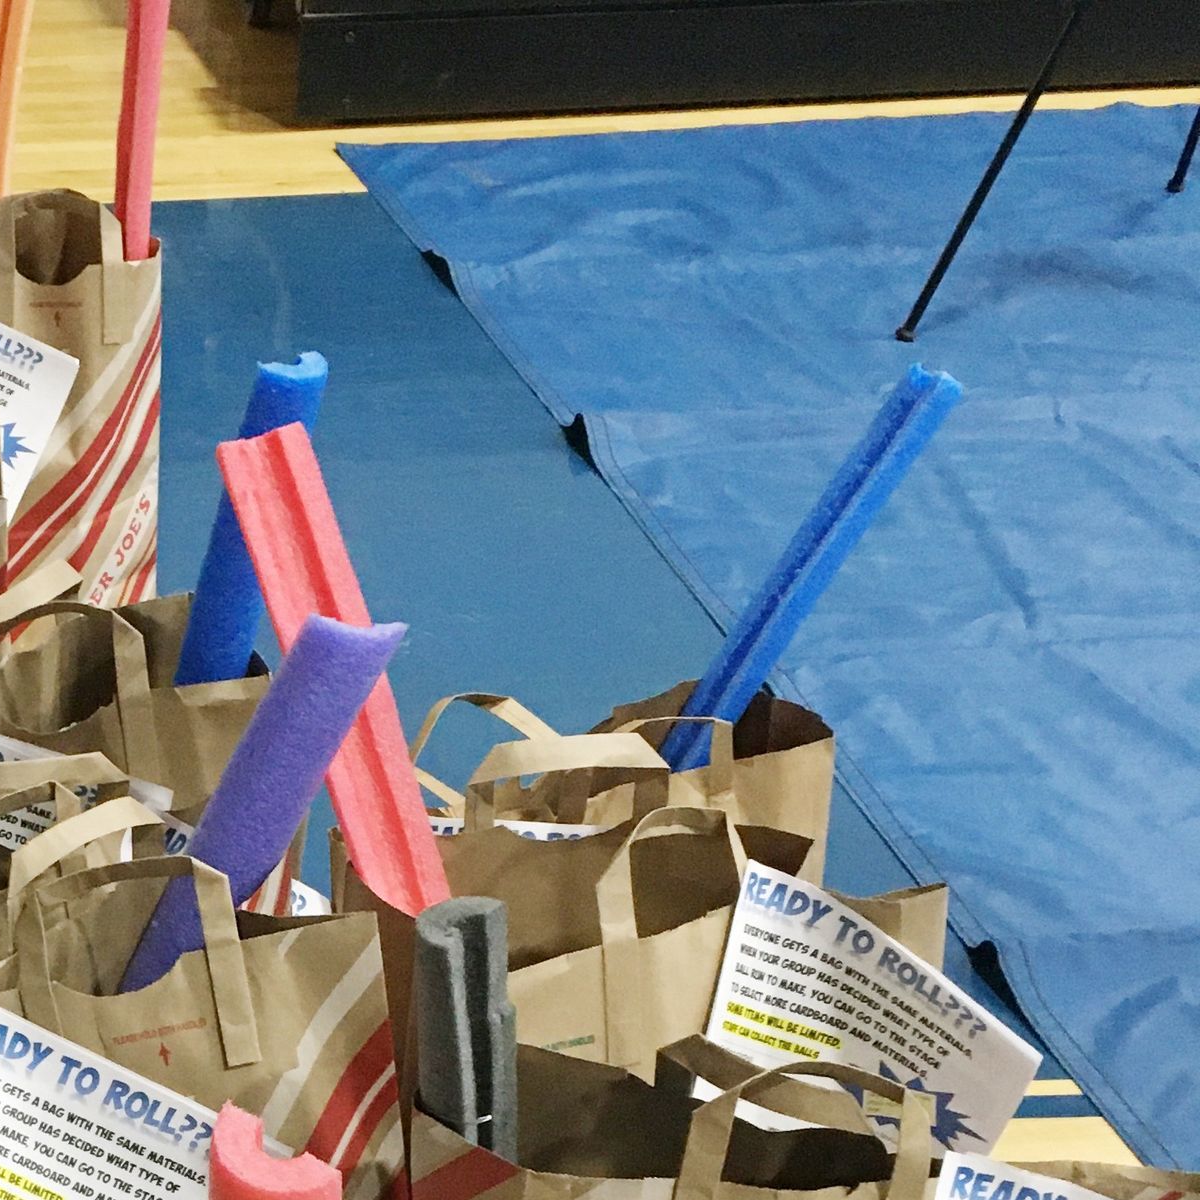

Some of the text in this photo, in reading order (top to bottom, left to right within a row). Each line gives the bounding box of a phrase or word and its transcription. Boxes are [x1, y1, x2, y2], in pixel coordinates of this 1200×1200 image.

[115, 493, 150, 566] JOE'S
[746, 872, 987, 1040] READY TO ROLL???
[3, 1083, 31, 1102] GETS
[31, 1097, 40, 1107] A
[41, 1100, 65, 1118] BAG
[66, 1112, 94, 1133] WITH
[96, 1124, 115, 1141] THE
[116, 1136, 147, 1156] SAME
[146, 1151, 206, 1187] MATERIALS.
[58, 1055, 100, 1095] TO
[103, 1079, 213, 1151] ROLL??
